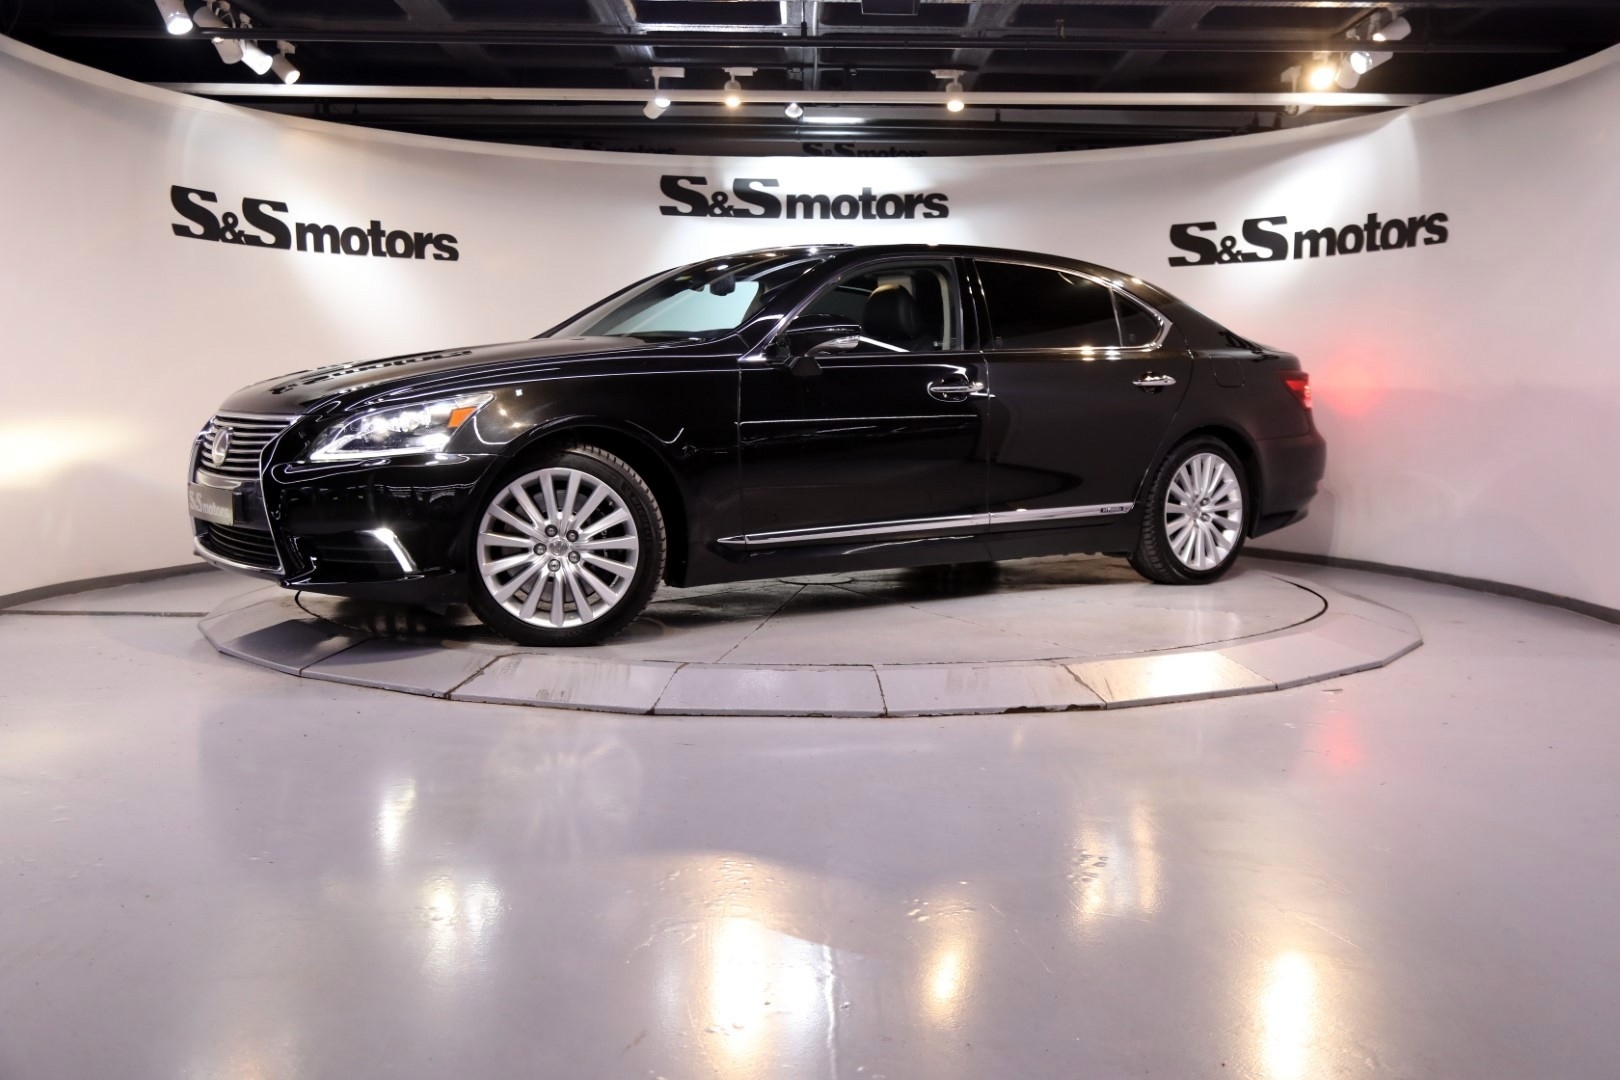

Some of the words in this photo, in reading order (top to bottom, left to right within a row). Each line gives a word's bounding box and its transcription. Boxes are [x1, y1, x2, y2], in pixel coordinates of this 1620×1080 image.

[170, 185, 292, 250] S&S
[295, 220, 459, 261] motors
[659, 175, 782, 219] S&S
[786, 187, 949, 220] motors
[1168, 215, 1289, 267] S&S
[1293, 212, 1449, 260] motors
